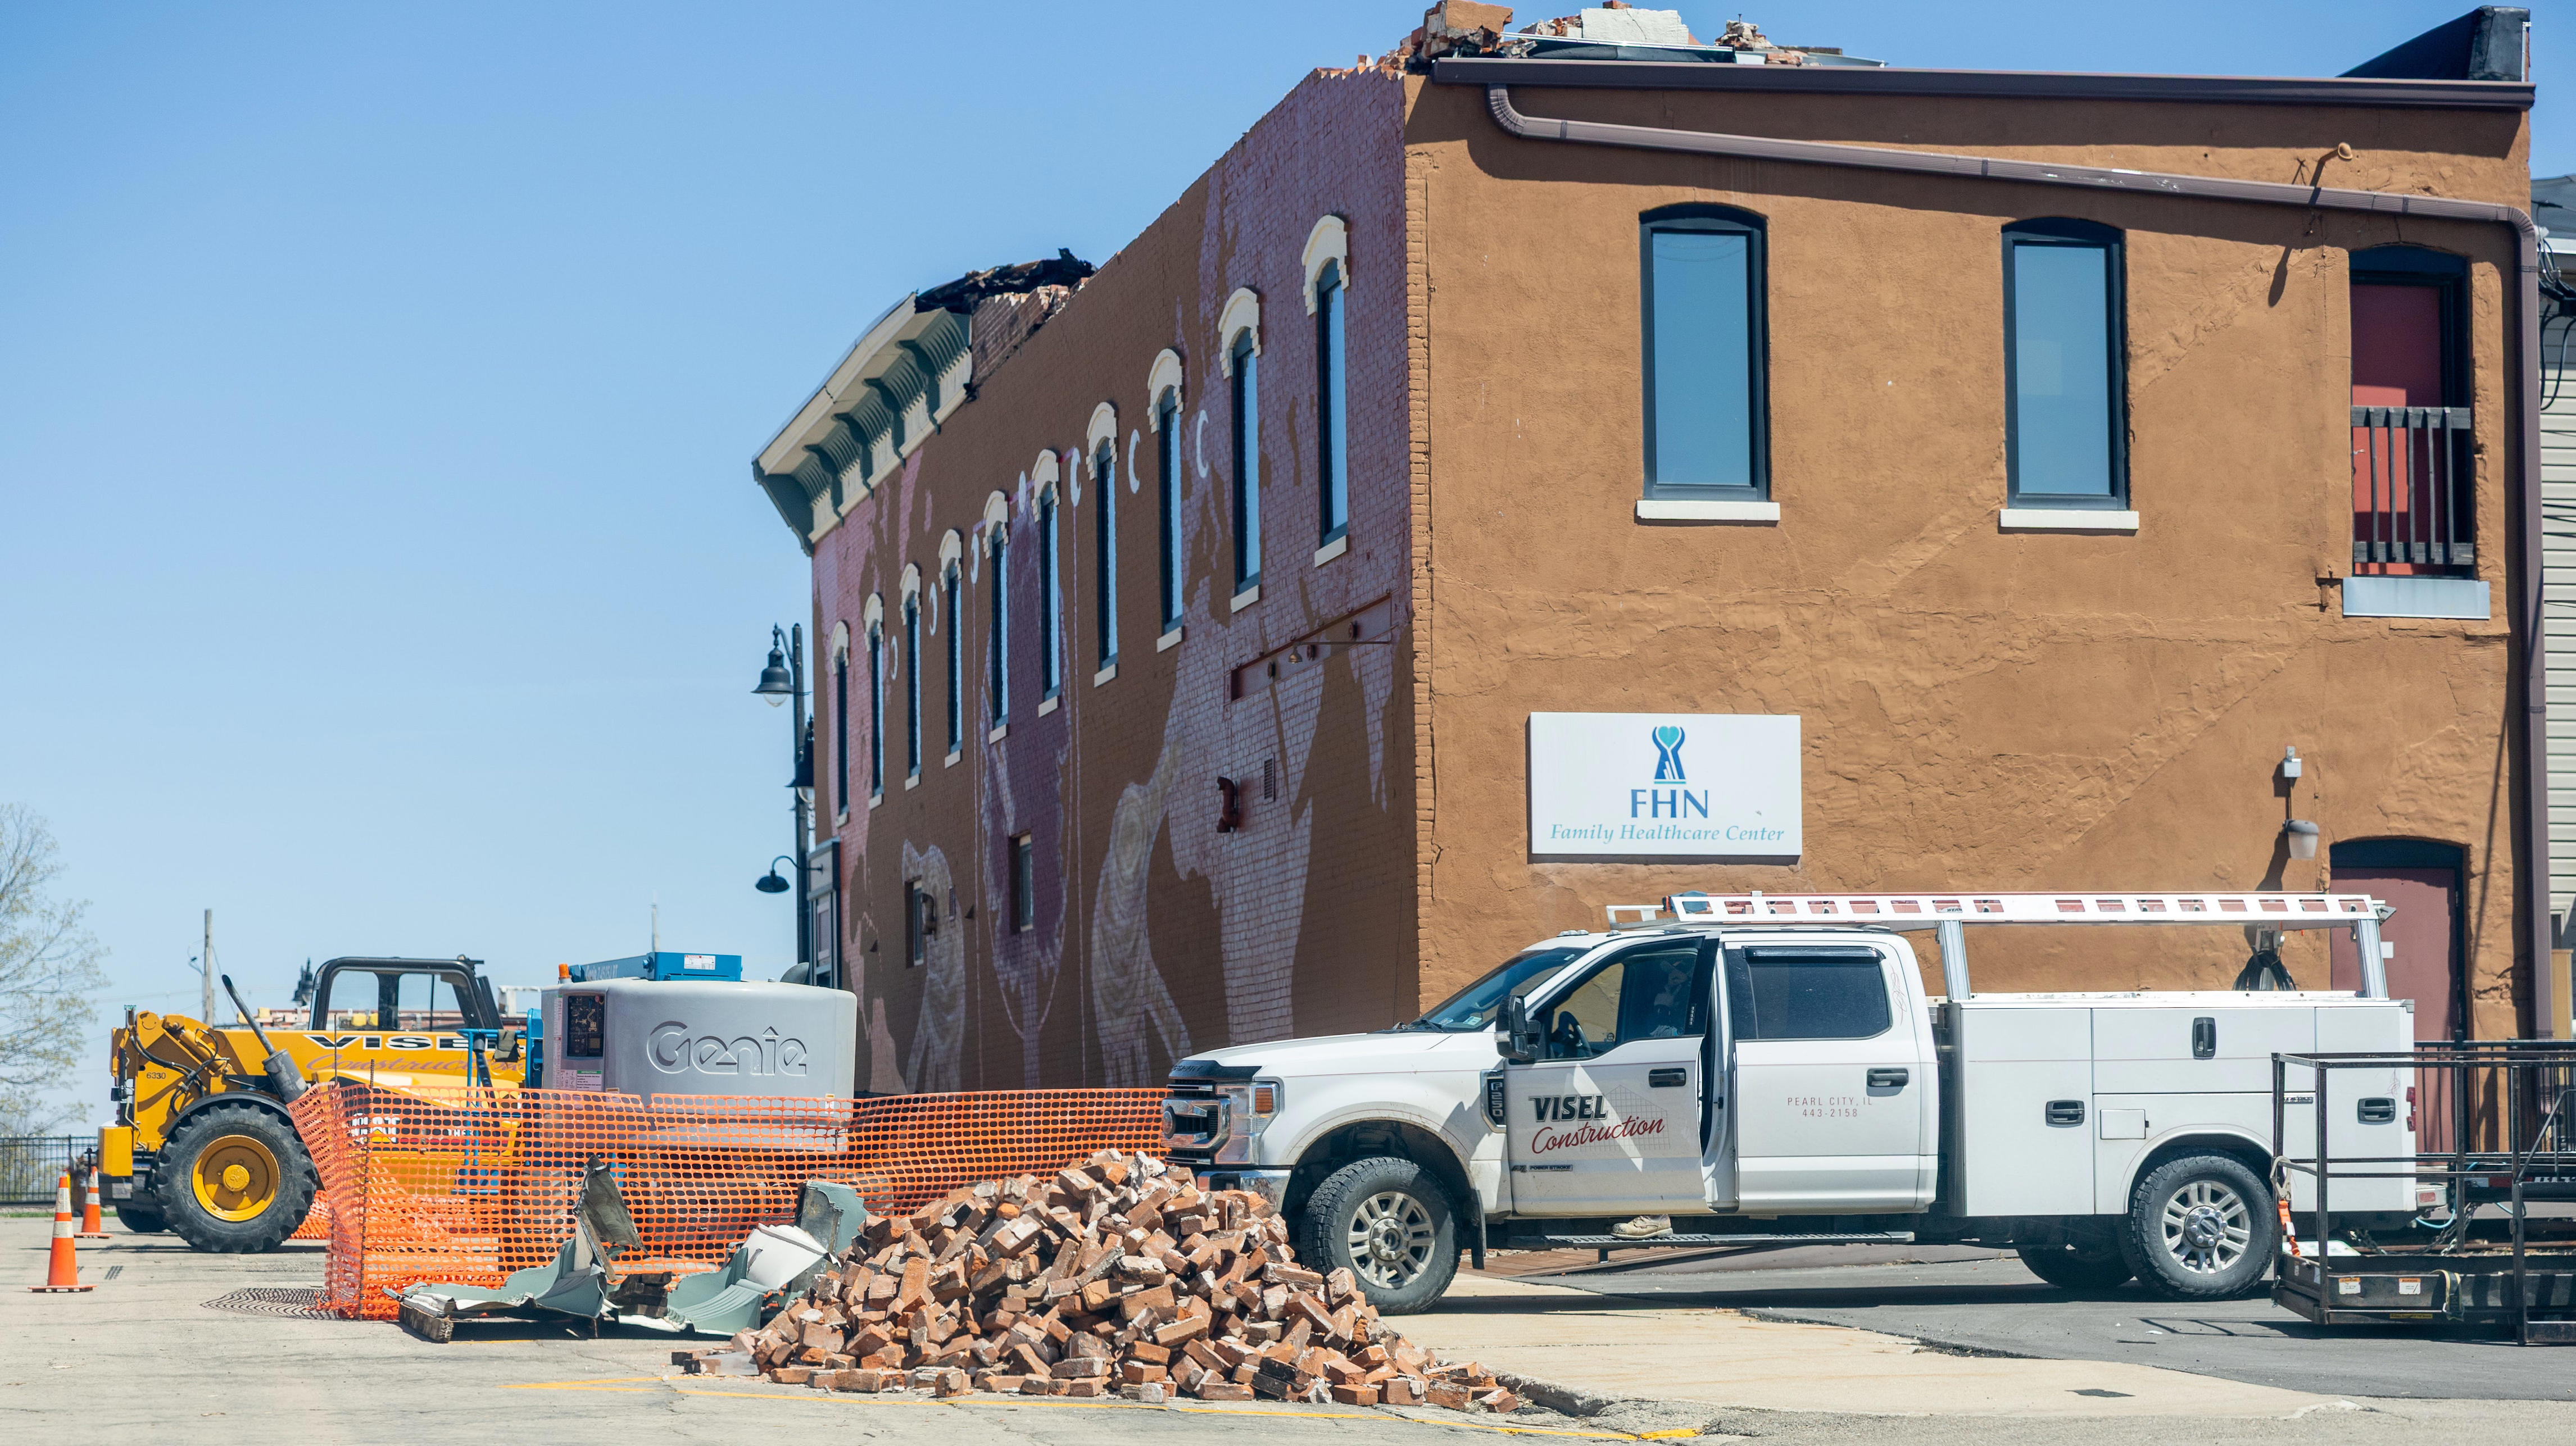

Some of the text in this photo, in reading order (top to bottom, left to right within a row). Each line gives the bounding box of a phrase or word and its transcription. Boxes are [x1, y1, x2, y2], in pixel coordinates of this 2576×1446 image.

[1631, 789, 1708, 819] FHN
[1550, 823, 1785, 844] Family Healthcare Center
[646, 1021, 807, 1076] Genie
[306, 1054, 524, 1072] Constructon
[1528, 1094, 1609, 1122] VISEL
[1788, 1097, 1822, 1106] PEARL
[1863, 1097, 1872, 1106] IL
[1802, 1108, 1858, 1117] 443-2158
[1532, 1115, 1665, 1154] Construction
